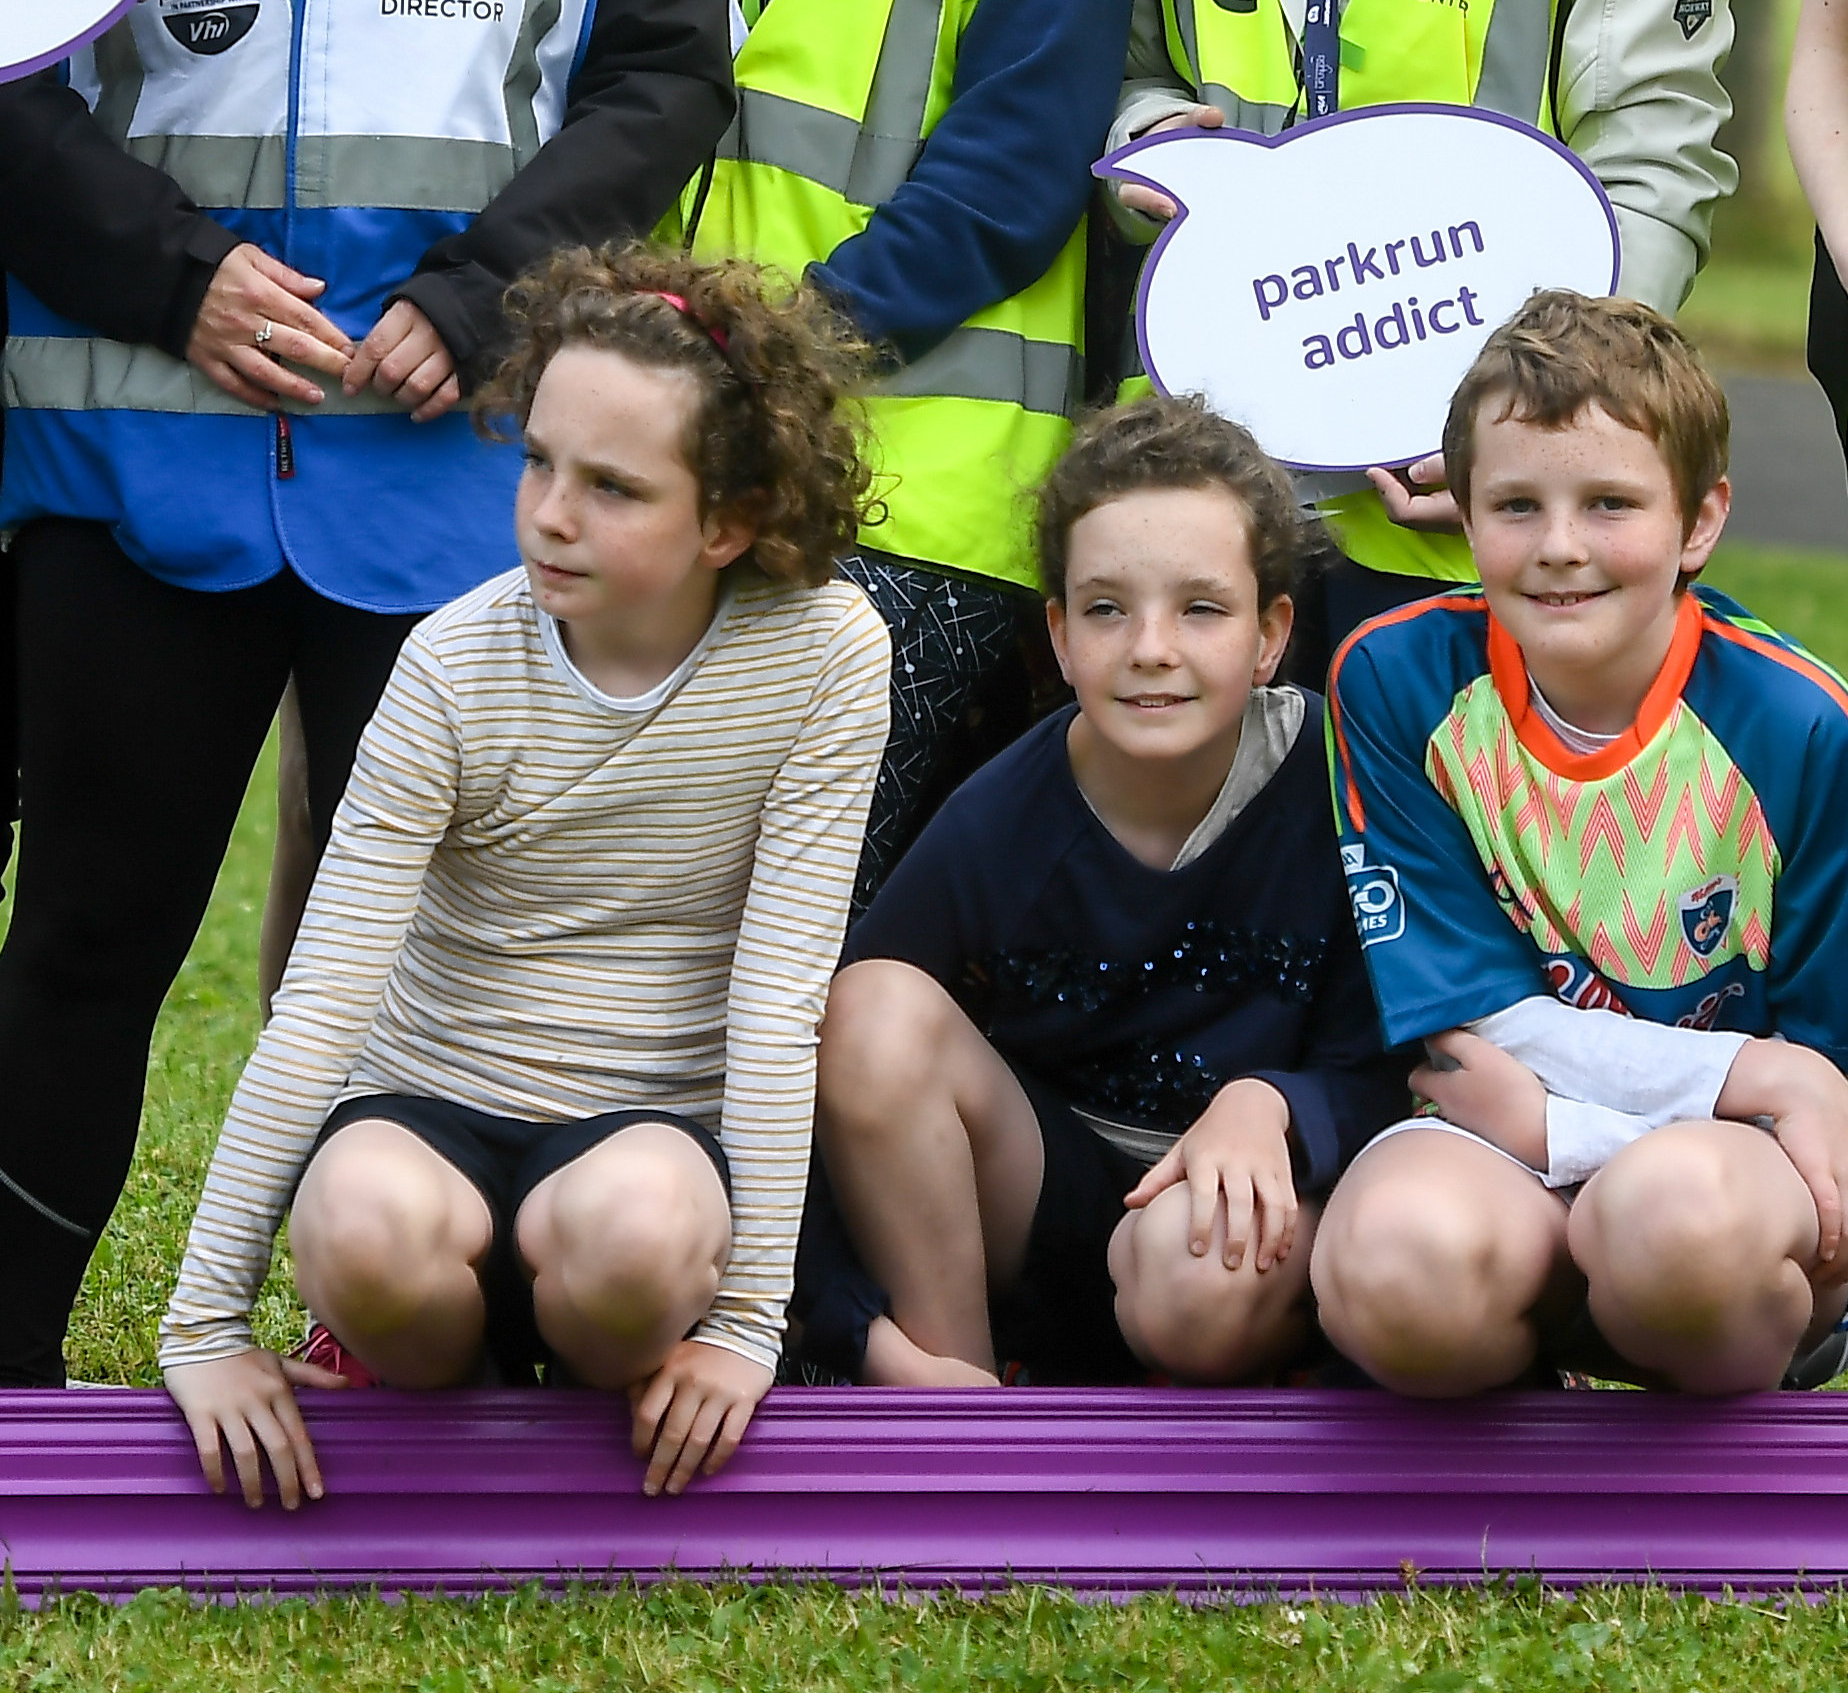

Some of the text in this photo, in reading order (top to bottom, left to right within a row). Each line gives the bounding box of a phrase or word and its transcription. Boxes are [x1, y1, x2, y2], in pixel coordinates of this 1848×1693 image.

[190, 20, 225, 42] Vhi
[1253, 221, 1484, 320] parkrun
[1302, 286, 1484, 369] addict
